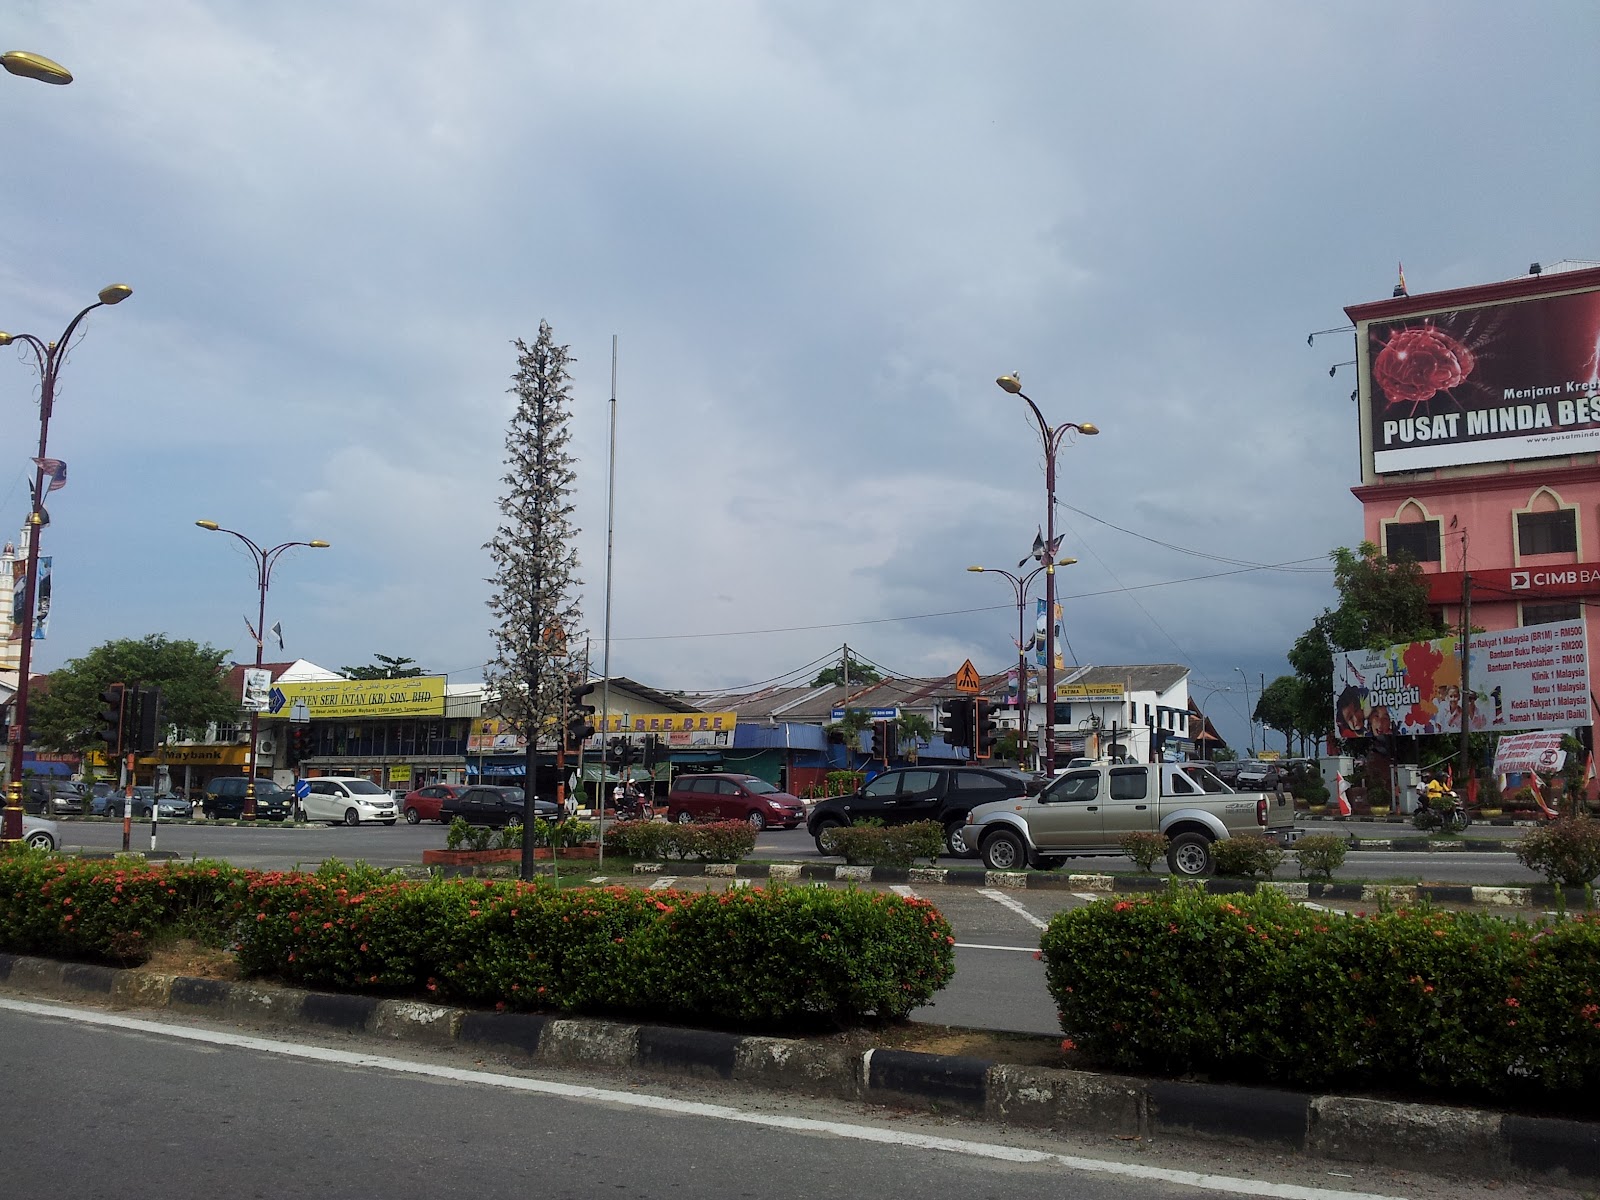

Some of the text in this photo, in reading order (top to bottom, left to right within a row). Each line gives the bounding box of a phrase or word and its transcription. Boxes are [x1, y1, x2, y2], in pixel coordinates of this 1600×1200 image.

[1503, 386, 1561, 400] Menjana
[1383, 396, 1600, 445] PUSAT MINDA BES
[1533, 571, 1577, 586] CIMB
[1477, 638, 1497, 650] Rakyat
[1503, 634, 1529, 645] Malaysia
[1531, 630, 1552, 641] (BR1M)
[1560, 626, 1582, 637] RM500
[1489, 650, 1513, 659] Bantuan
[1515, 647, 1530, 656] Buku
[1532, 644, 1553, 655] Pelajar
[1561, 640, 1583, 651] RM200
[1488, 663, 1511, 672] Bantuan
[1513, 658, 1554, 669] Persekolahan
[1562, 654, 1584, 665] RM100
[1532, 671, 1549, 680] Klinik
[1556, 668, 1585, 680] Malaysia
[1373, 672, 1404, 692] Janji
[1533, 685, 1550, 694] Menu
[1557, 682, 1586, 694] Malaysia
[320, 694, 339, 706] SERI
[341, 693, 366, 705] INTAN
[369, 692, 386, 706] (KB)
[1370, 687, 1420, 710] Ditepati
[1511, 699, 1528, 709] Kedai
[1530, 699, 1551, 709] Rakyat
[1558, 696, 1587, 707] Malaysia
[1509, 713, 1530, 722] Rumah
[1537, 711, 1564, 722] Malaysia
[1566, 709, 1587, 721] (Baiki)
[635, 718, 673, 730] BEE
[683, 717, 723, 730] BEE
[165, 751, 222, 760] Maybank
